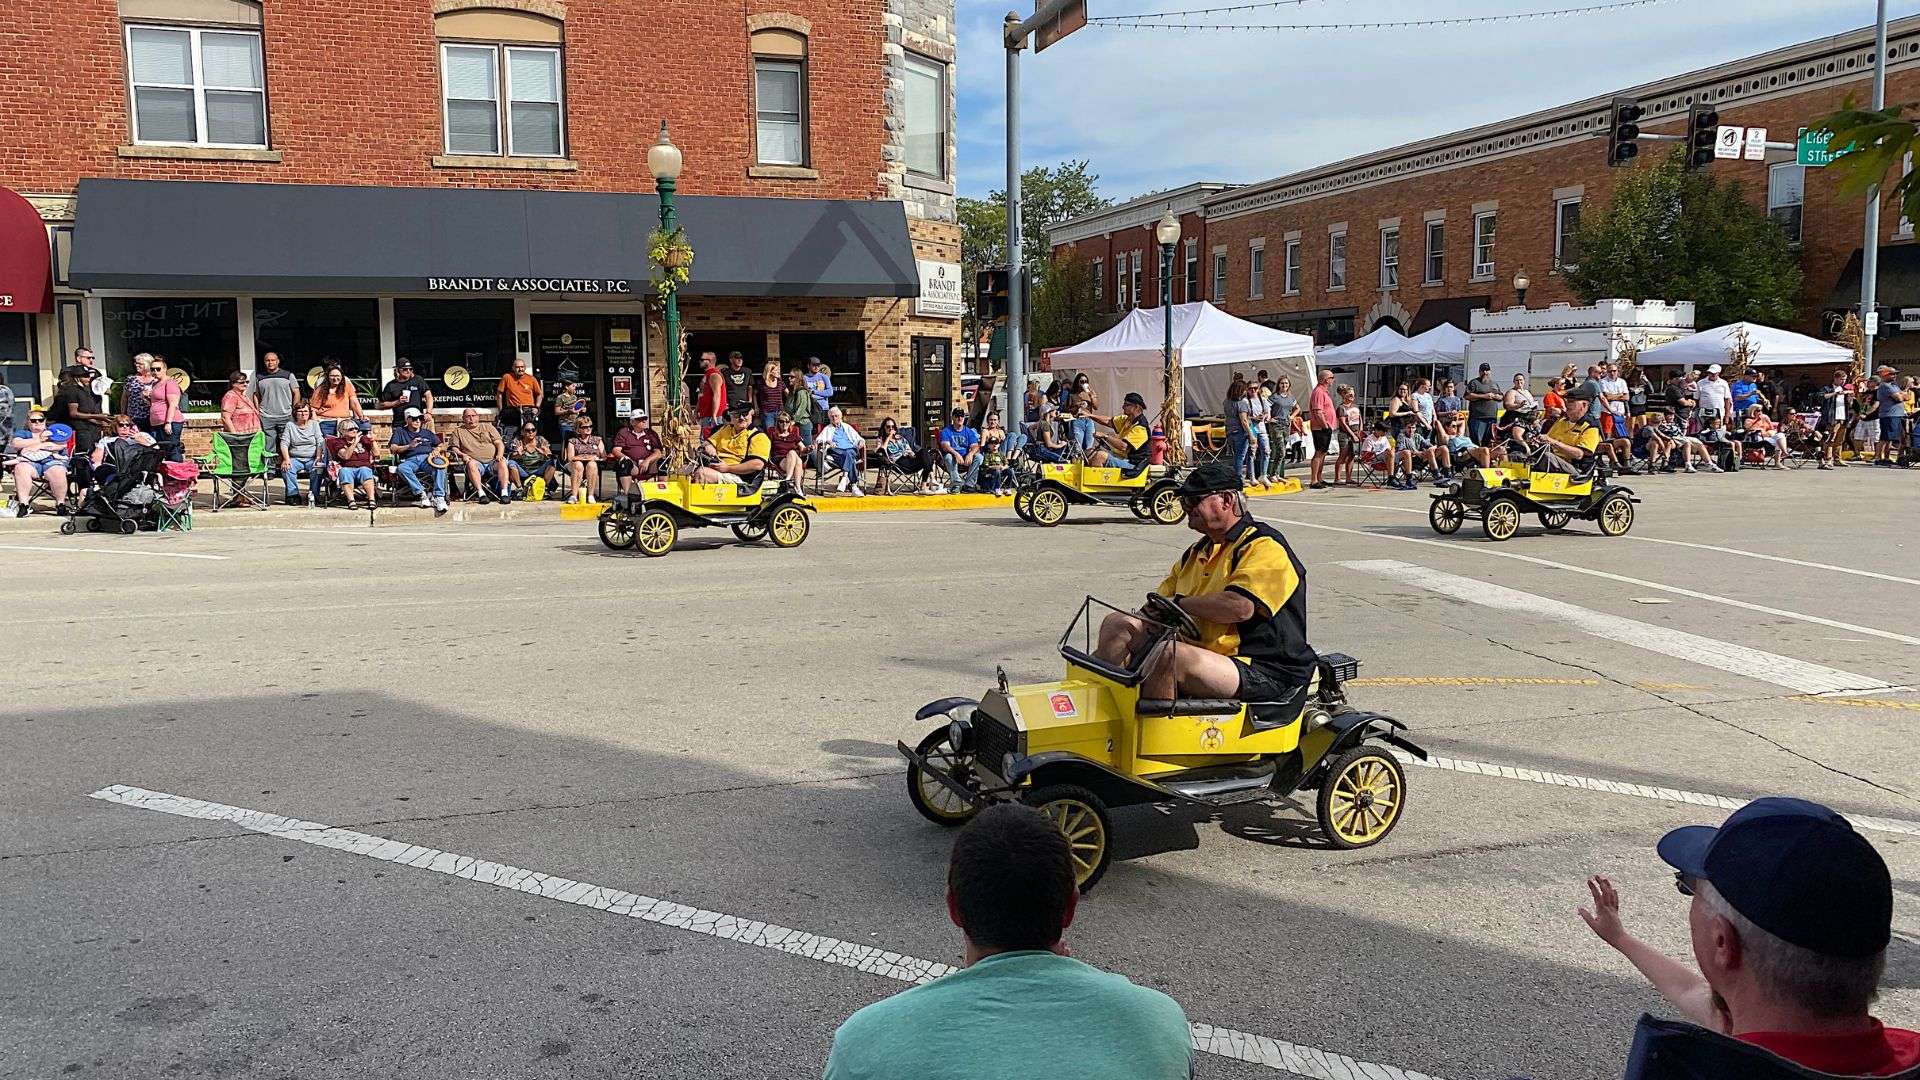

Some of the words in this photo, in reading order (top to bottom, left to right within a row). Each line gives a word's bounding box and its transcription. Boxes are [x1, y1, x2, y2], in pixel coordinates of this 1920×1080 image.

[1806, 132, 1834, 144] LIBE
[428, 278, 493, 290] BRANDT
[497, 278, 509, 290] &
[512, 278, 602, 293] ASSOCIATES,
[607, 280, 630, 292] P.C.
[928, 278, 956, 292] BRANDT
[465, 394, 472, 402] &
[473, 394, 499, 402] PAYRO
